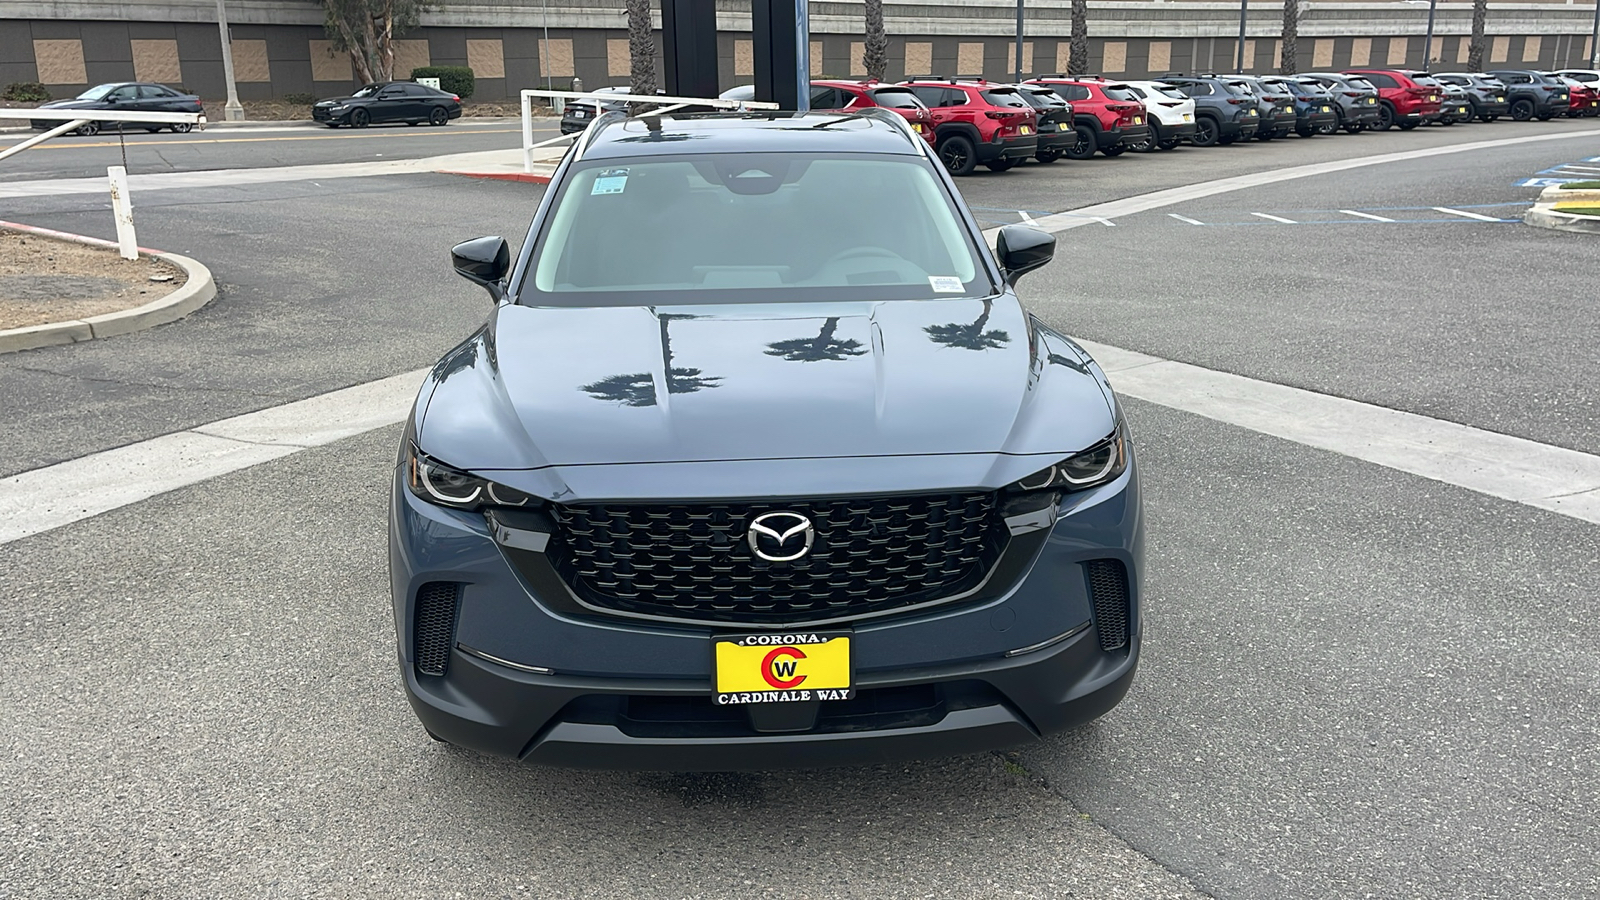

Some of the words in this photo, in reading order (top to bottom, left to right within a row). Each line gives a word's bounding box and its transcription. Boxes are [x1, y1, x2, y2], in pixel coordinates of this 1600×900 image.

[745, 633, 820, 645] CORONA
[774, 660, 797, 678] W
[718, 690, 811, 705] CARDINALE
[816, 689, 850, 701] WAY
